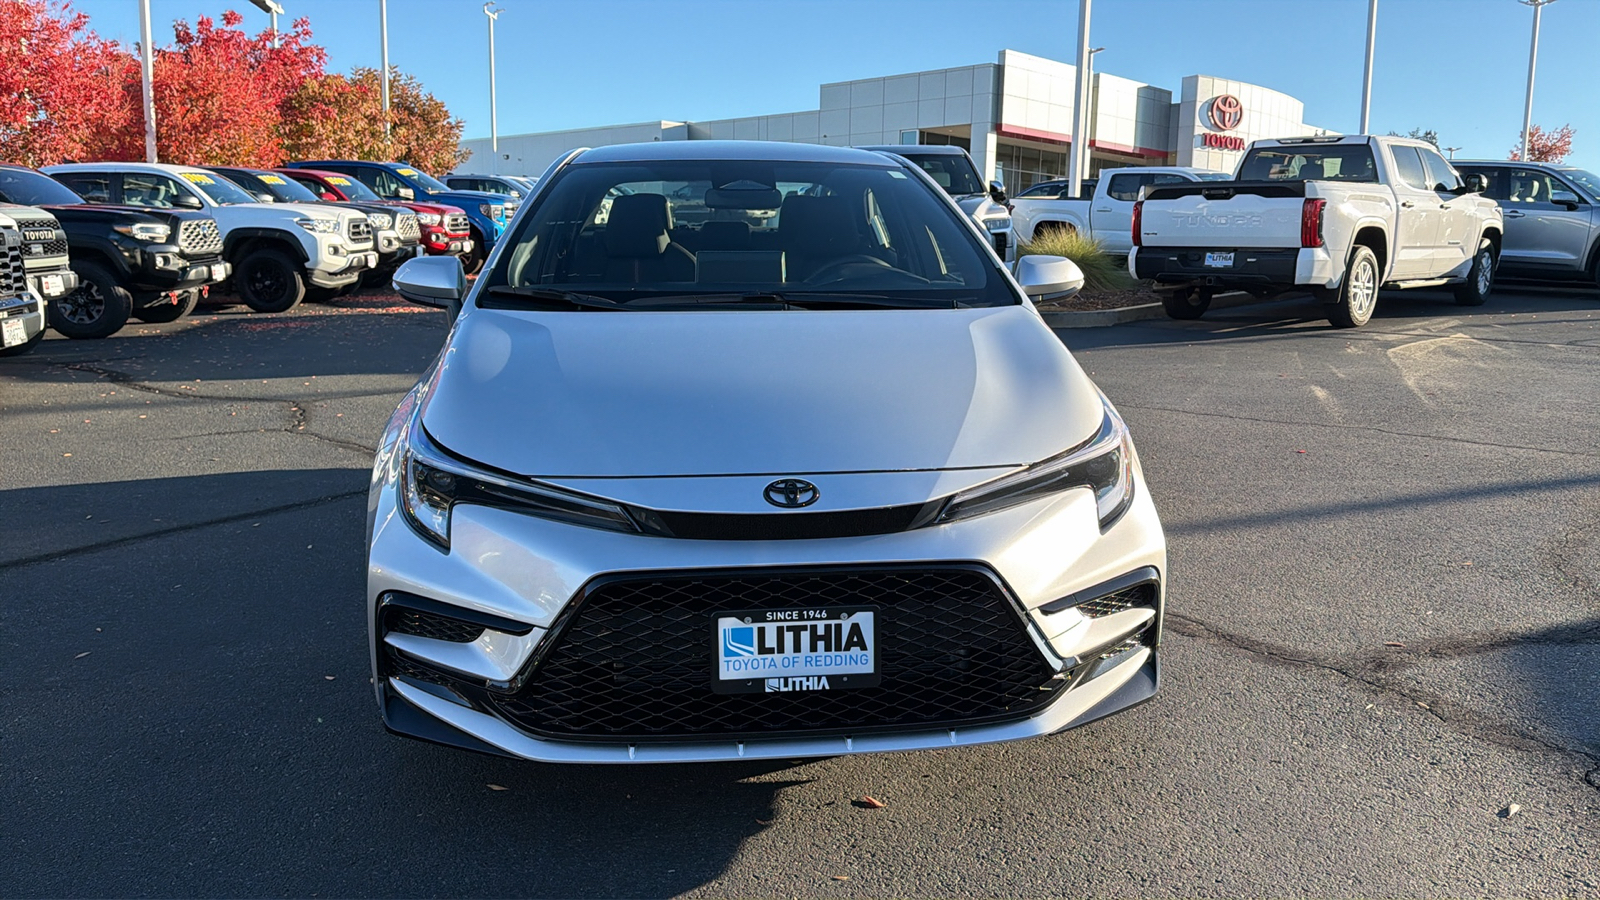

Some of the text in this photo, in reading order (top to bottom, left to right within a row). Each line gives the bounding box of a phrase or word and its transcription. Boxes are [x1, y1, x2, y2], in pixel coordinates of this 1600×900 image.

[1202, 133, 1245, 150] TOYOTA
[1172, 215, 1262, 228] TUNDRA
[24, 231, 53, 240] TOYOTA
[766, 610, 827, 620] SINCE 1946
[757, 622, 868, 655] LITHIA
[724, 653, 869, 672] TOYOTA OF REDDING
[779, 676, 830, 691] LITHIA
